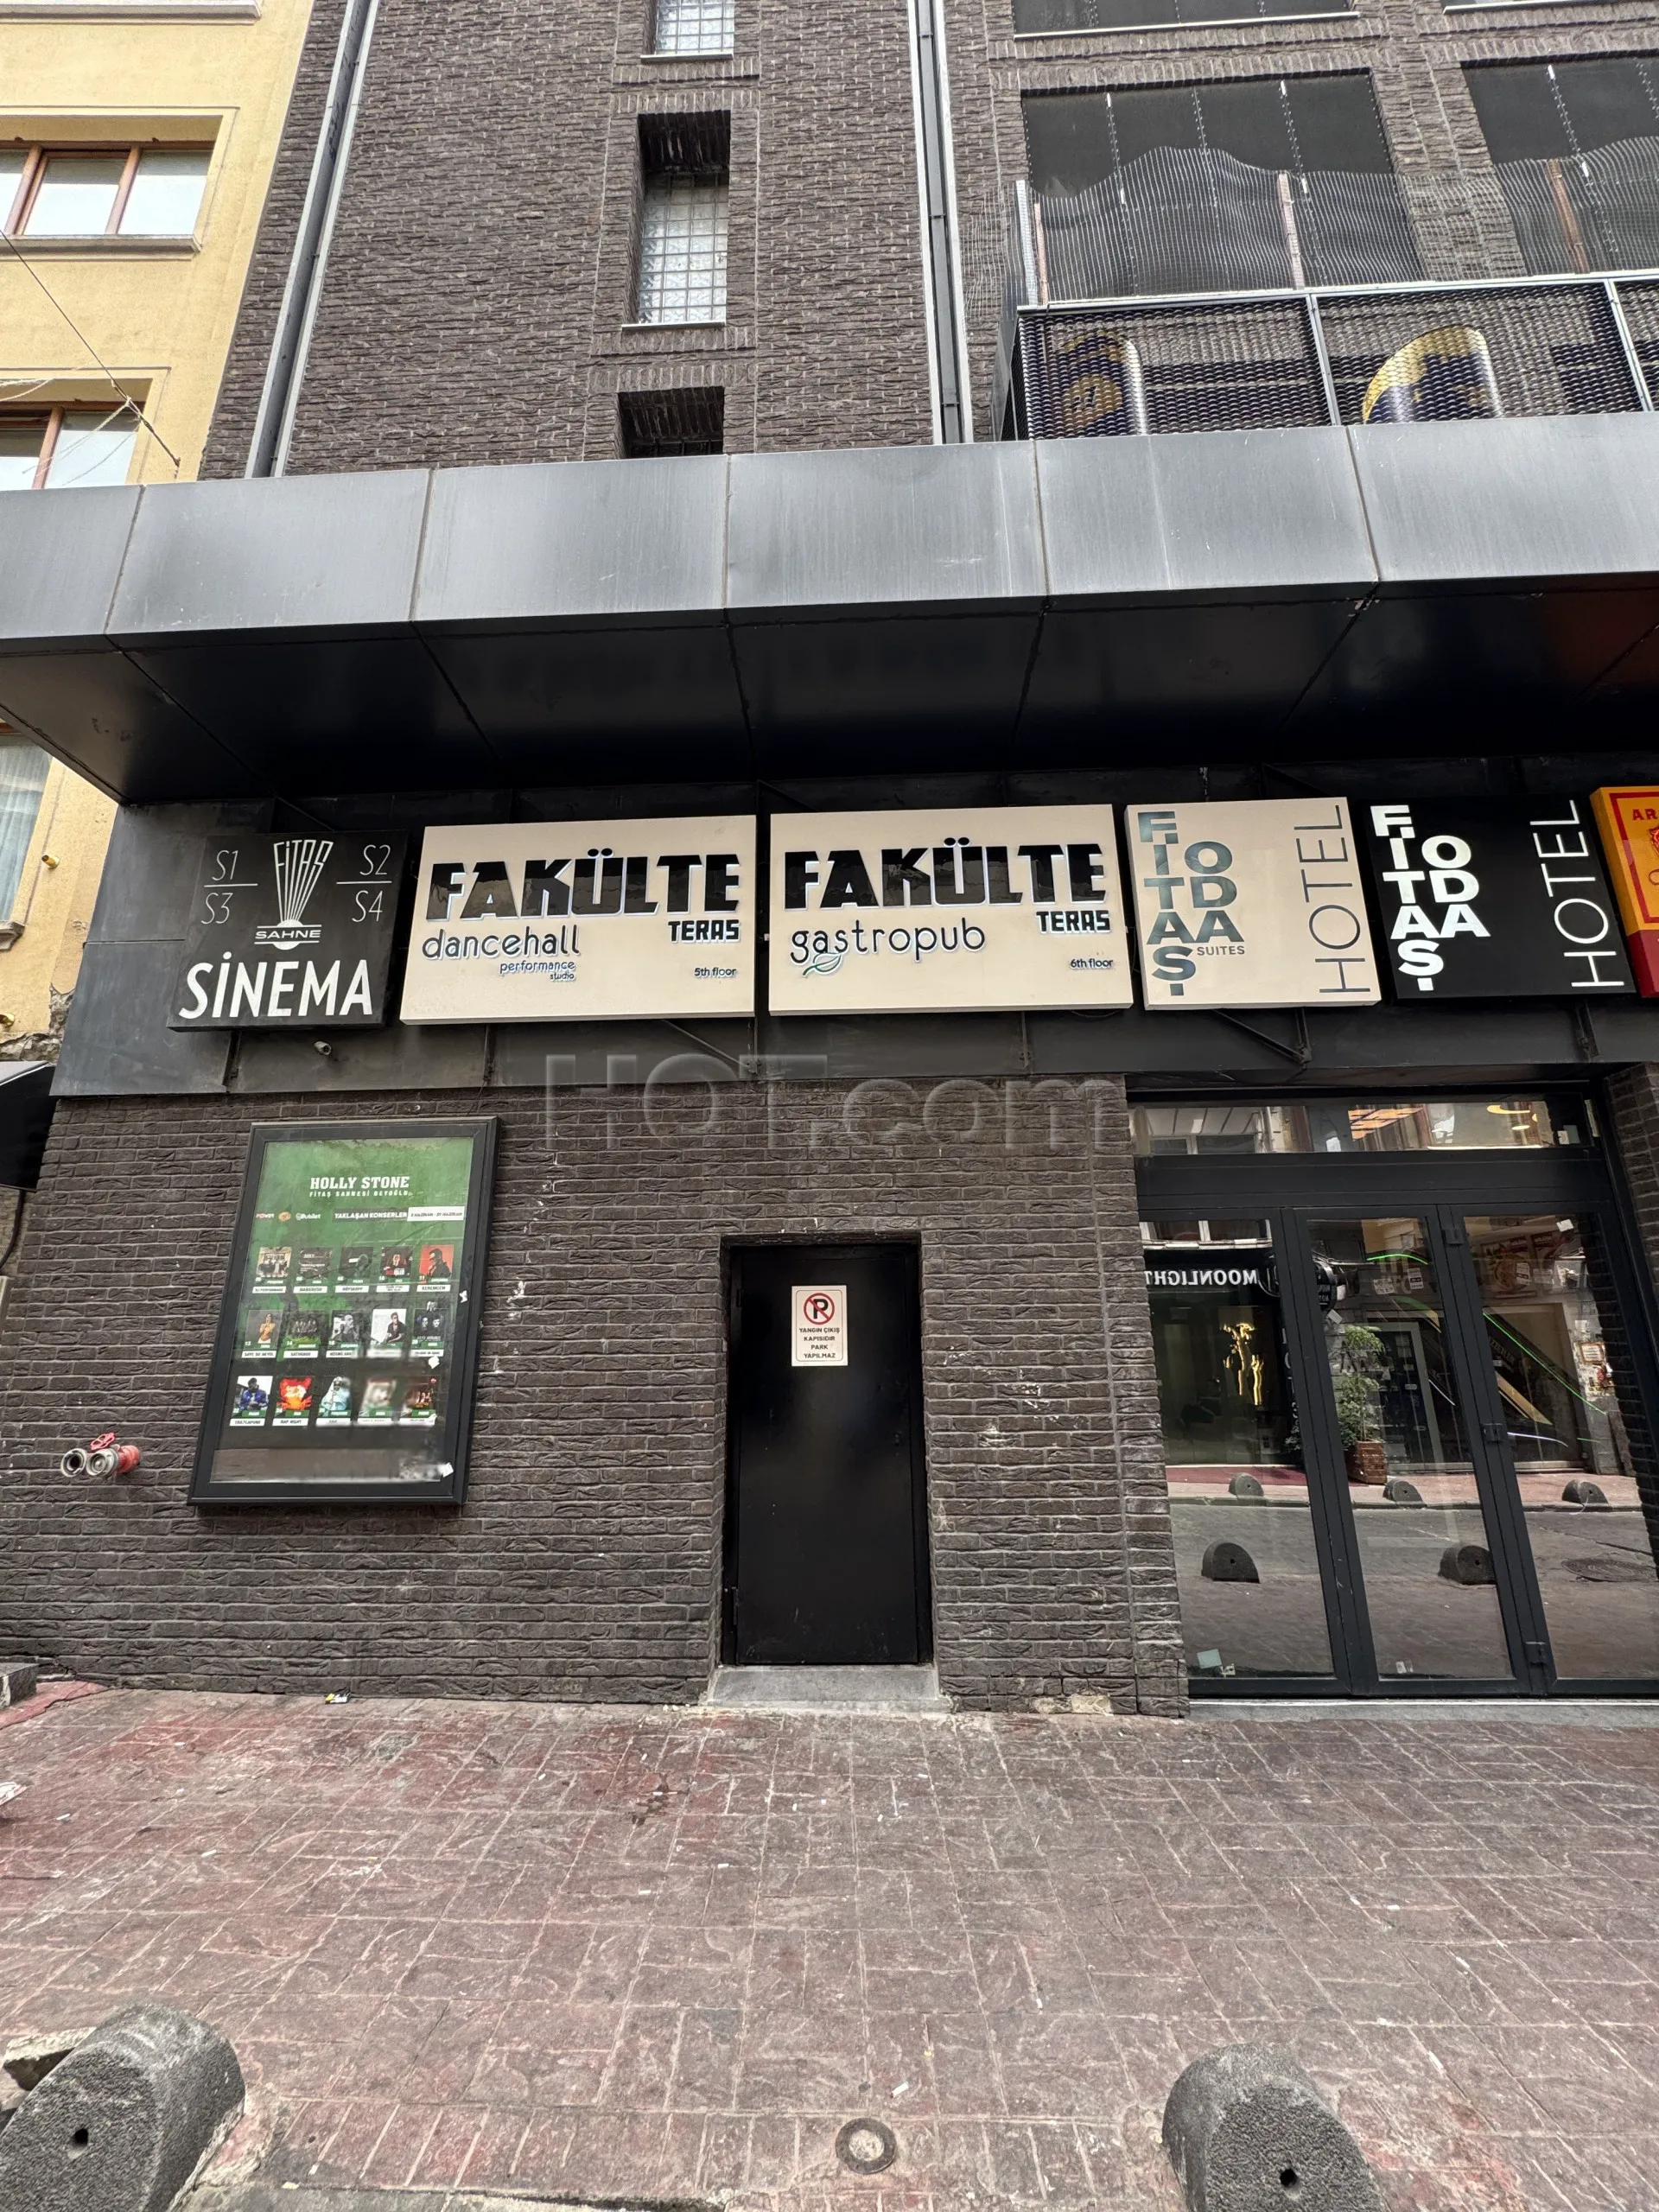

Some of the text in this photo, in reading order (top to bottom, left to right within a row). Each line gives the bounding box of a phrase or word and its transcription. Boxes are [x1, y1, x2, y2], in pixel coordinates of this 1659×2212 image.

[1631, 809, 1659, 821] AR
[212, 849, 238, 880] S1
[359, 844, 391, 875] S2
[785, 836, 1106, 910] FAKÜLTE
[425, 847, 741, 921] FAKÜLTE
[1294, 804, 1371, 994] HOTEL
[1529, 800, 1624, 987] HOTEL
[200, 892, 233, 925] S3
[352, 890, 383, 922] S4
[1036, 909, 1111, 933] TERAS
[255, 929, 321, 939] SAHNE
[422, 925, 581, 959] dancehall
[668, 918, 741, 943] TERAS
[790, 918, 986, 964] gastropub
[1071, 957, 1114, 969] 6th floor
[1197, 945, 1245, 956] SUITES
[499, 960, 575, 975] performance
[550, 971, 575, 981] studio
[694, 966, 737, 977] 5th floor
[178, 951, 373, 1020] SİNEMA
[309, 1175, 410, 1190] HOLLY STONE
